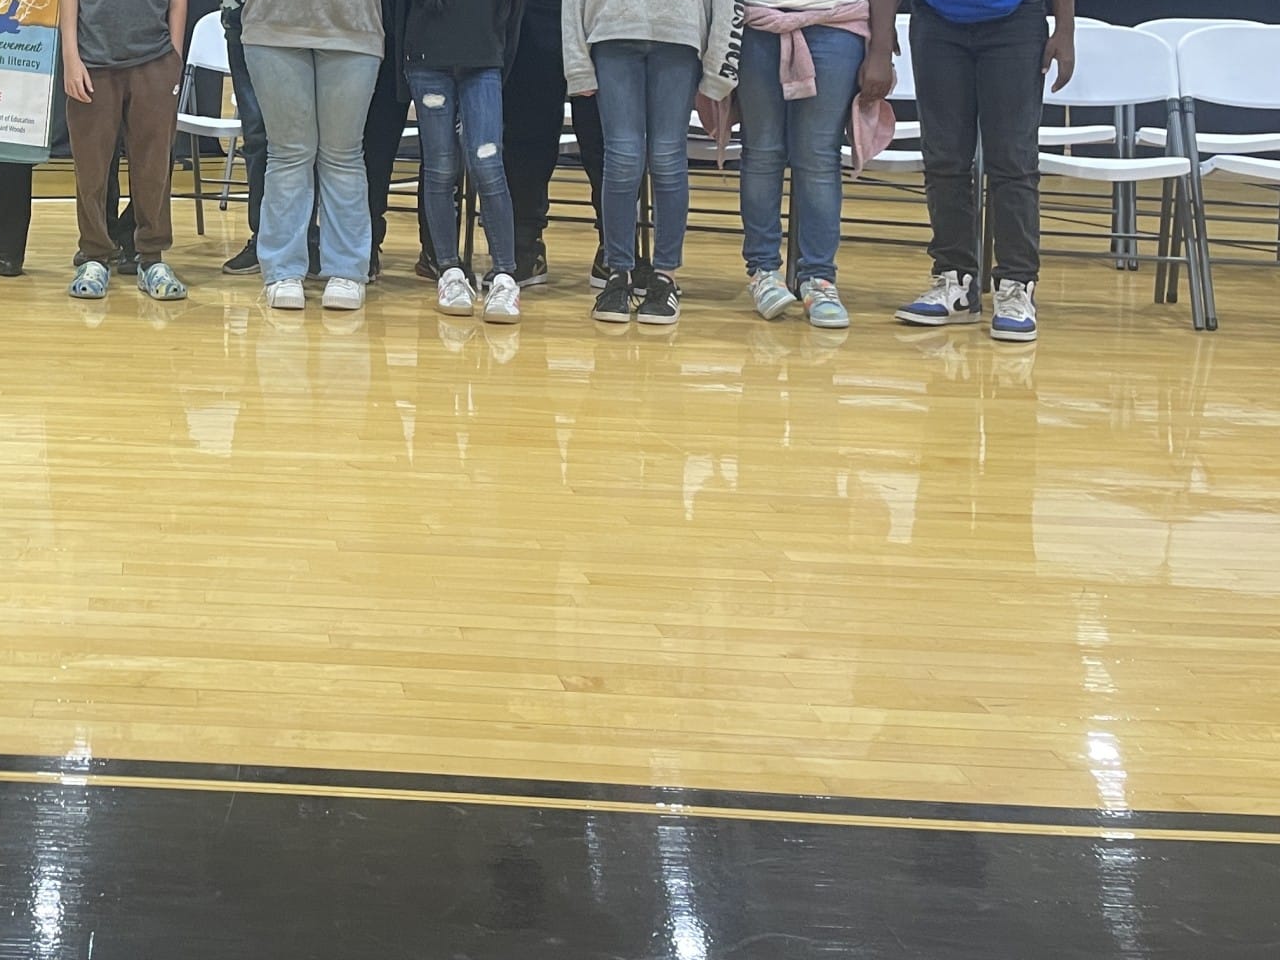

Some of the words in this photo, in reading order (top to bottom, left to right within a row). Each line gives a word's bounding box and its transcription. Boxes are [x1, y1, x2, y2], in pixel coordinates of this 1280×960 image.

[7, 56, 41, 70] literacy
[5, 113, 11, 121] of
[10, 114, 35, 125] Education
[9, 124, 26, 134] Woods
